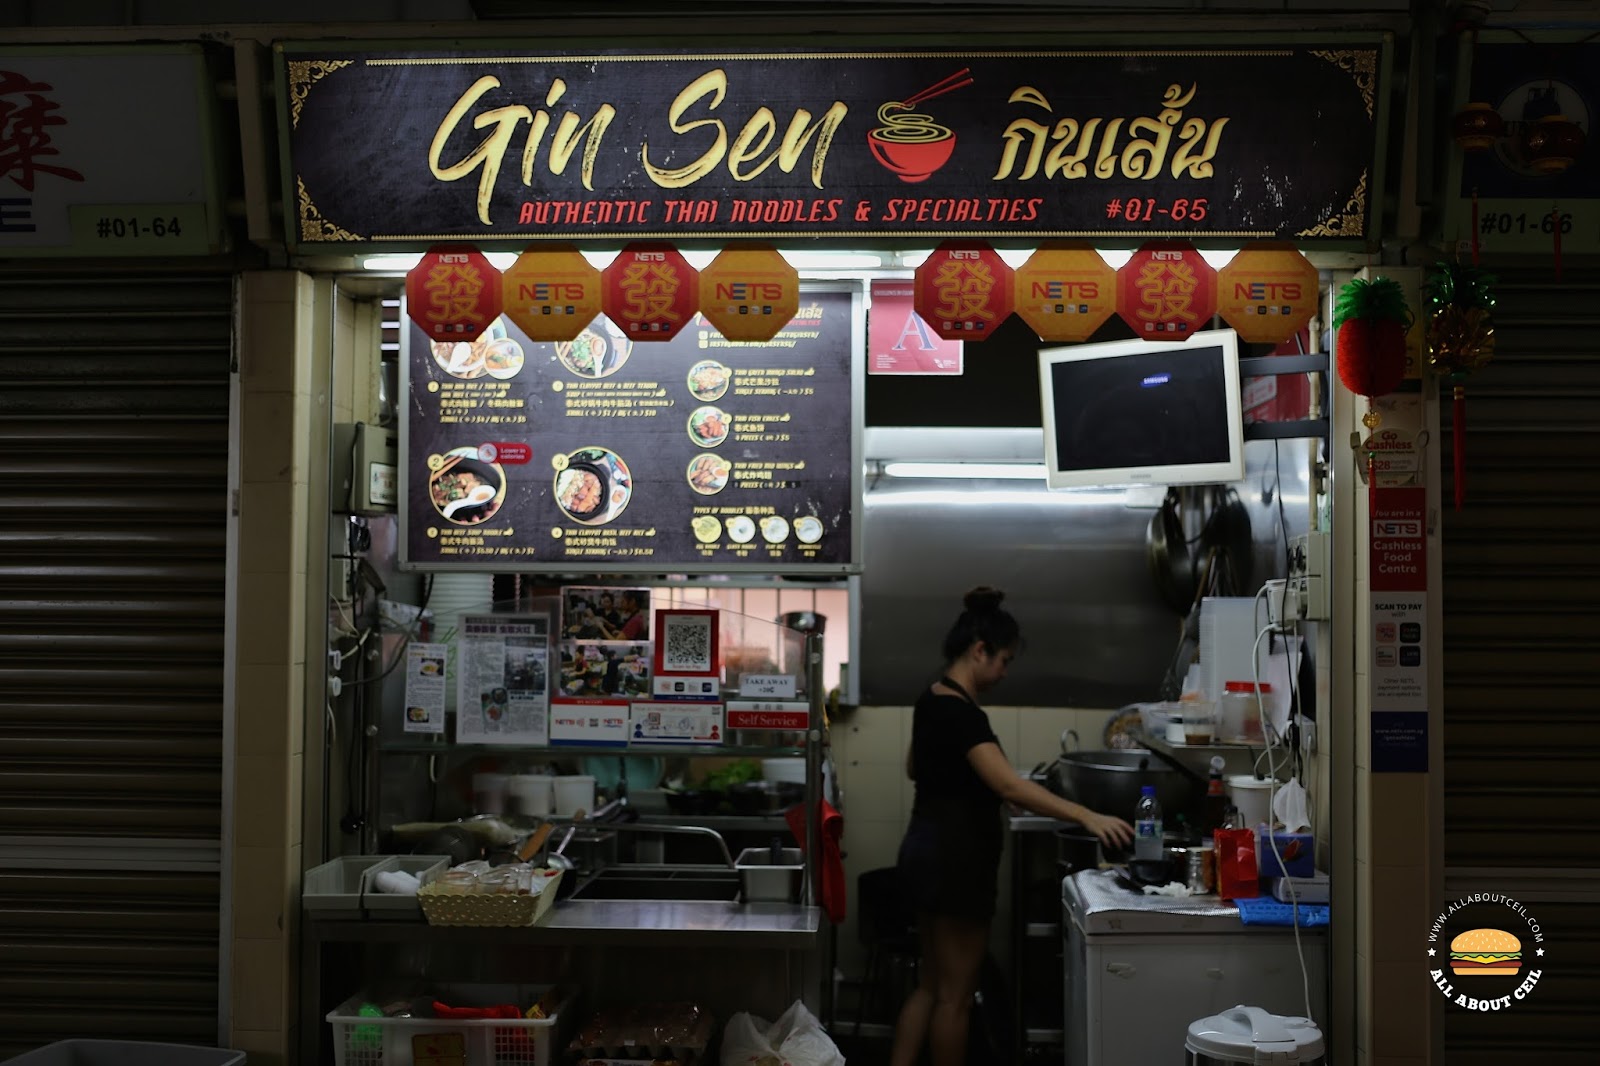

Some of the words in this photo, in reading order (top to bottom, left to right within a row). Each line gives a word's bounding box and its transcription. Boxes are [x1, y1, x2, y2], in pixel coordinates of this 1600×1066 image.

[992, 81, 1231, 181] กินเส้น
[428, 74, 617, 226] Gin
[642, 68, 849, 190] Sen
[518, 199, 651, 225] AUTHENTIC
[663, 199, 719, 225] THAI
[729, 198, 843, 224] NOODLES
[854, 200, 872, 222] &
[882, 198, 1044, 223] SPECIALTIES
[1106, 198, 1208, 223] #01-65
[97, 216, 182, 238] #01-64
[1481, 213, 1573, 234] #01-66
[439, 254, 469, 263] NETS
[635, 252, 666, 262] NETS
[949, 250, 980, 260] NETS
[1152, 251, 1183, 261] NETS
[519, 283, 585, 301] NETS
[716, 283, 783, 301] NETS
[1031, 281, 1099, 299] NETS
[1234, 283, 1302, 301] NETS
[891, 310, 939, 352] A
[1381, 431, 1398, 440] Go
[1365, 440, 1413, 450] Cashless
[1405, 509, 1414, 517] in
[1376, 522, 1418, 535] NETS
[1373, 540, 1423, 551] Cashless
[1383, 552, 1412, 562] Food
[1378, 563, 1418, 574] Centre
[737, 713, 759, 726] Self
[760, 714, 798, 726] Service
